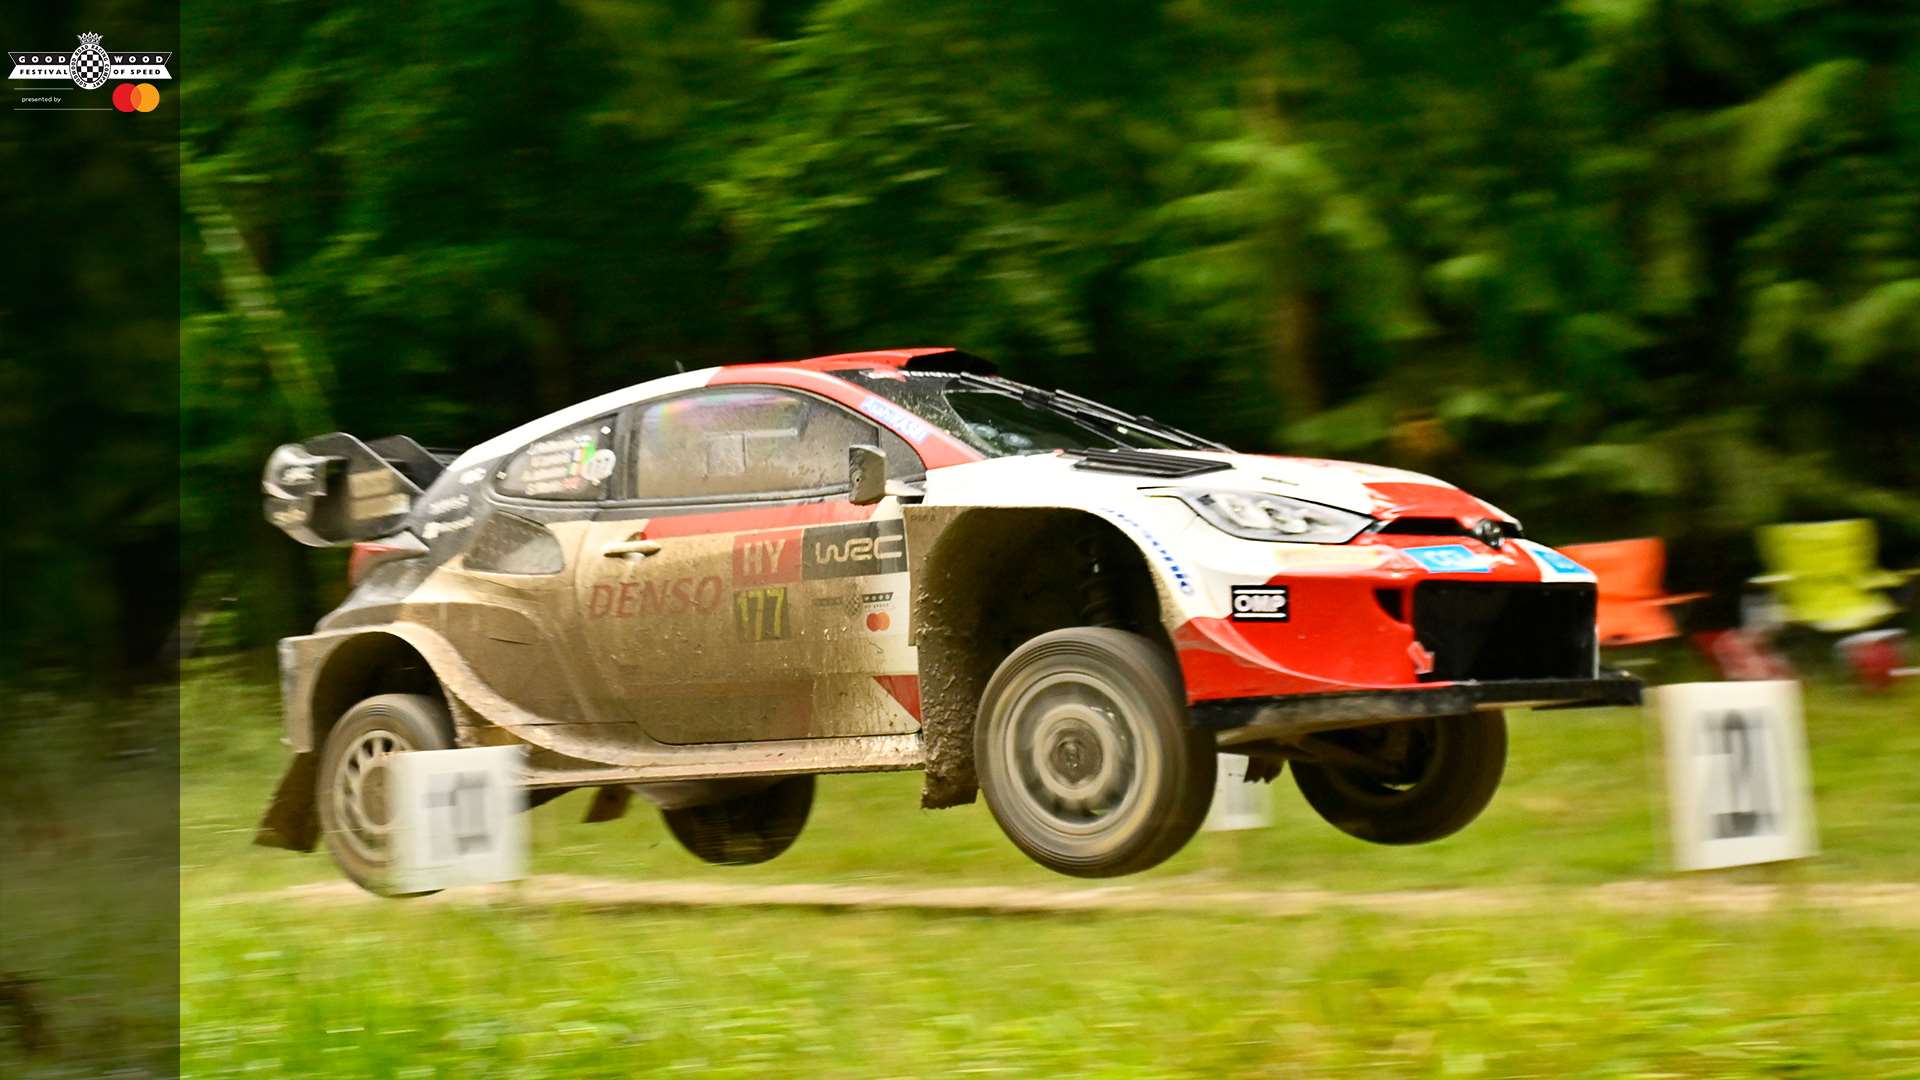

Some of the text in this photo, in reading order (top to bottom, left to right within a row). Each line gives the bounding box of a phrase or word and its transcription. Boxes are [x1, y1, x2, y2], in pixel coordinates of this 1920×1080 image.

[743, 538, 786, 576] HY
[815, 534, 903, 565] WRC
[590, 575, 723, 620] DENSO
[737, 586, 785, 641] 177
[1234, 594, 1287, 612] OMP
